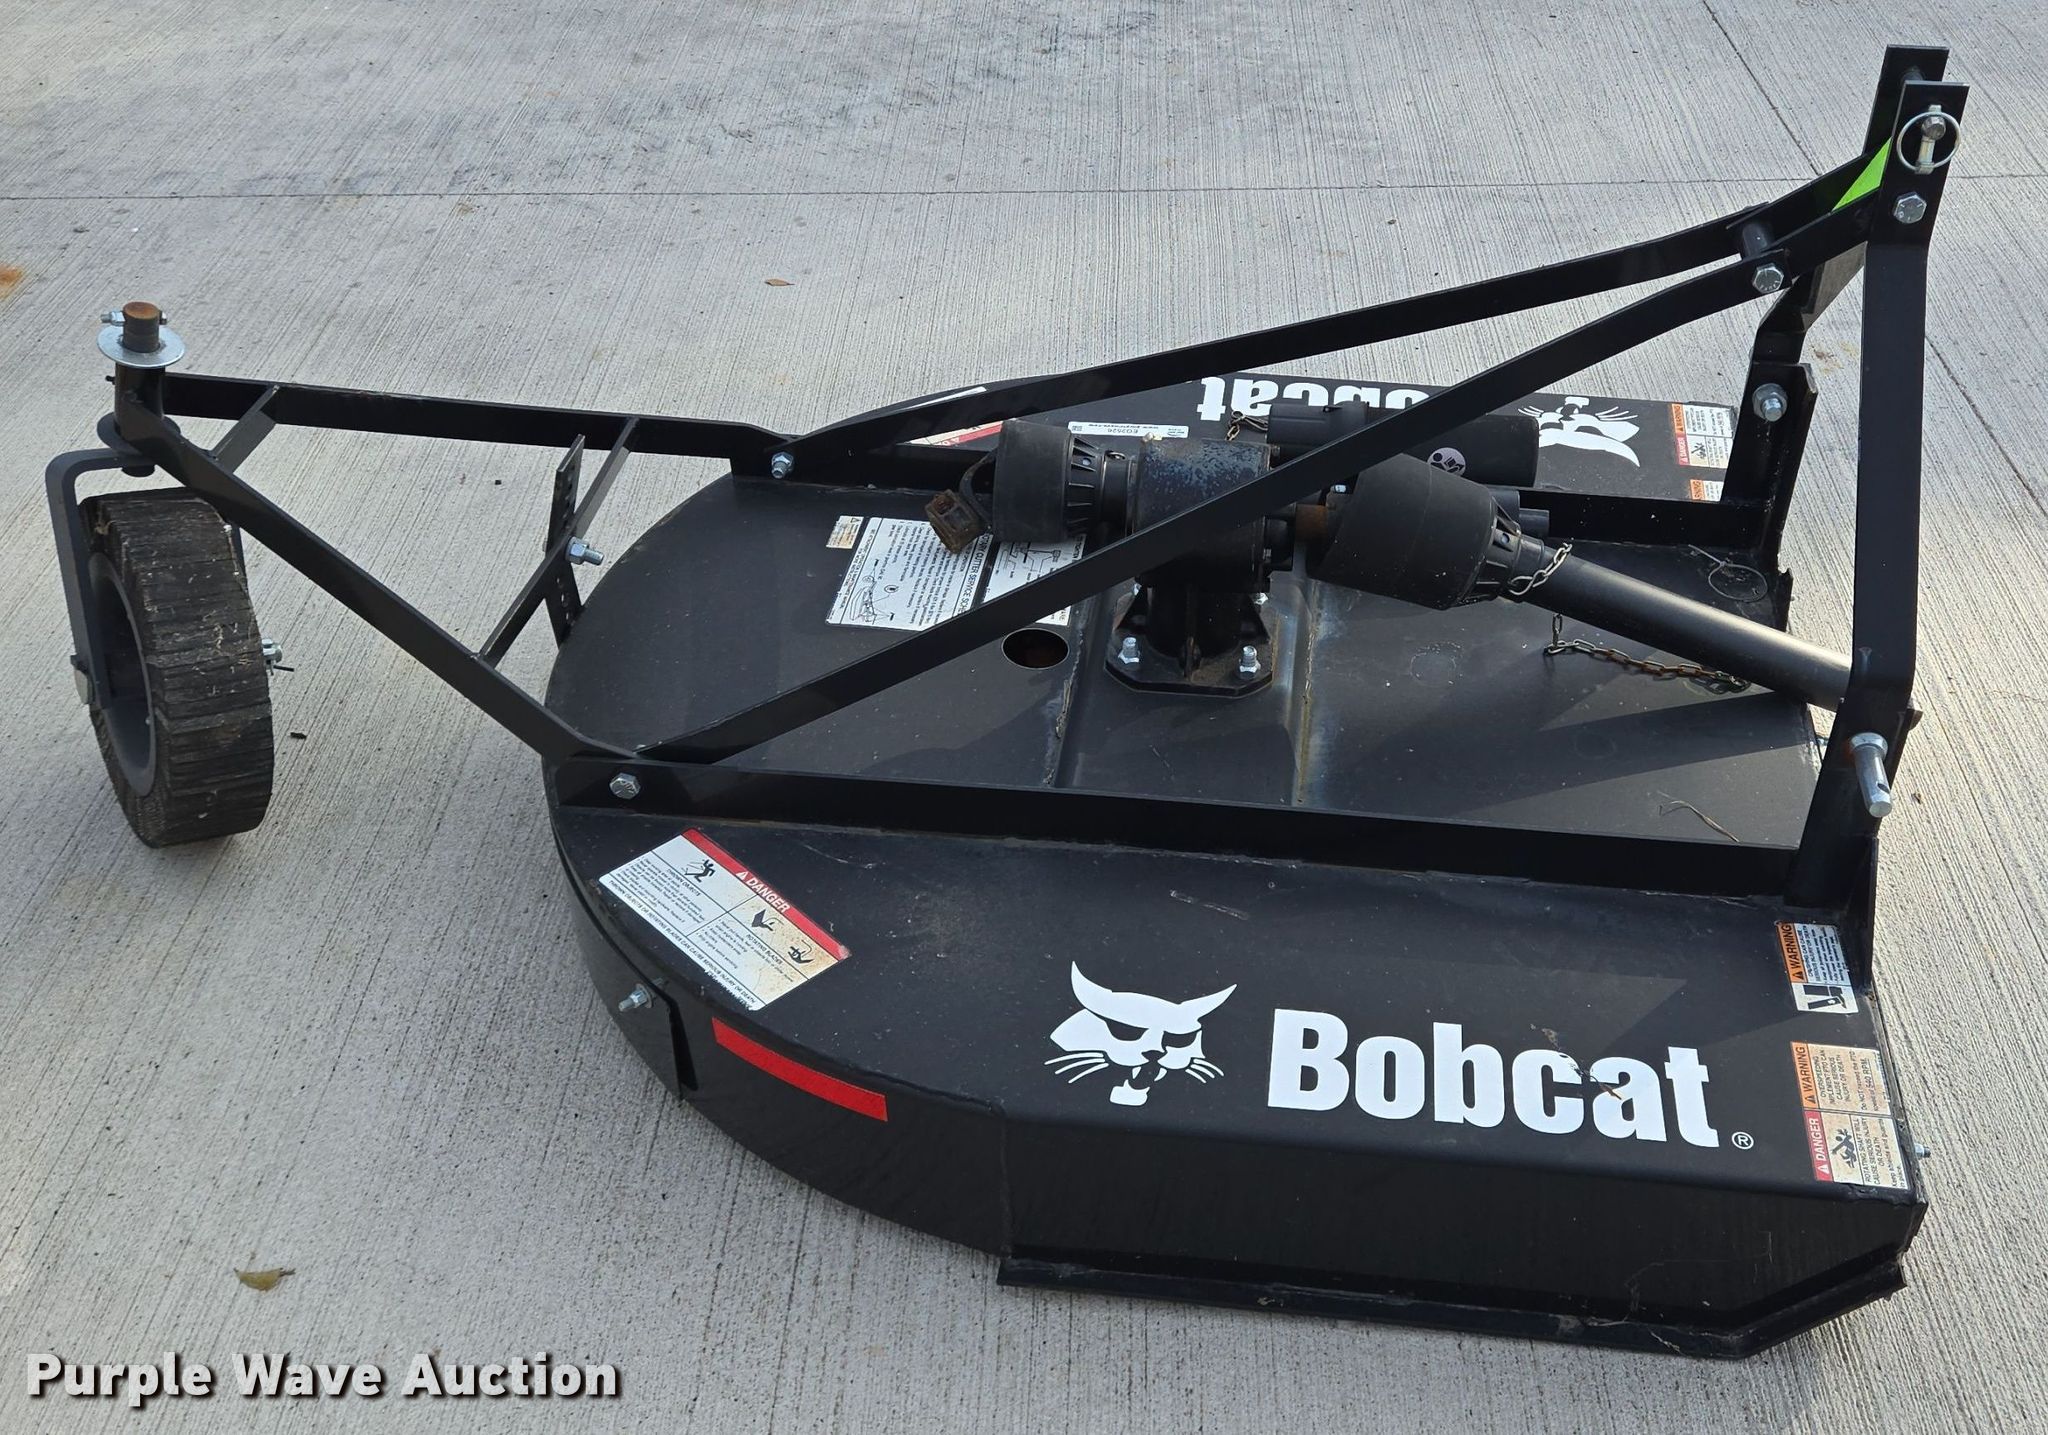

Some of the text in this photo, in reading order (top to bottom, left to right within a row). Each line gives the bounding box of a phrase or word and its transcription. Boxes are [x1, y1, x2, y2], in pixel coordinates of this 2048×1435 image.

[969, 551, 984, 573] CUTTER
[961, 573, 977, 597] SERVICE
[744, 876, 792, 913] DANGER
[1780, 924, 1801, 969] WARNING
[1267, 1009, 1719, 1147] Bobcat
[1795, 1046, 1814, 1092] WARNING
[1827, 1056, 1843, 1100] CAUSE SERIOUS
[1834, 1054, 1845, 1072] DEATH
[1863, 1075, 1873, 1088] 540
[1808, 1117, 1826, 1161] DANGER
[1855, 1132, 1865, 1152] SHAFT
[1864, 1137, 1876, 1164] SERIOUS
[1872, 1136, 1885, 1166] OR DEATH
[1859, 1151, 1871, 1182] ROTATING
[1870, 1165, 1881, 1184] CAUSE
